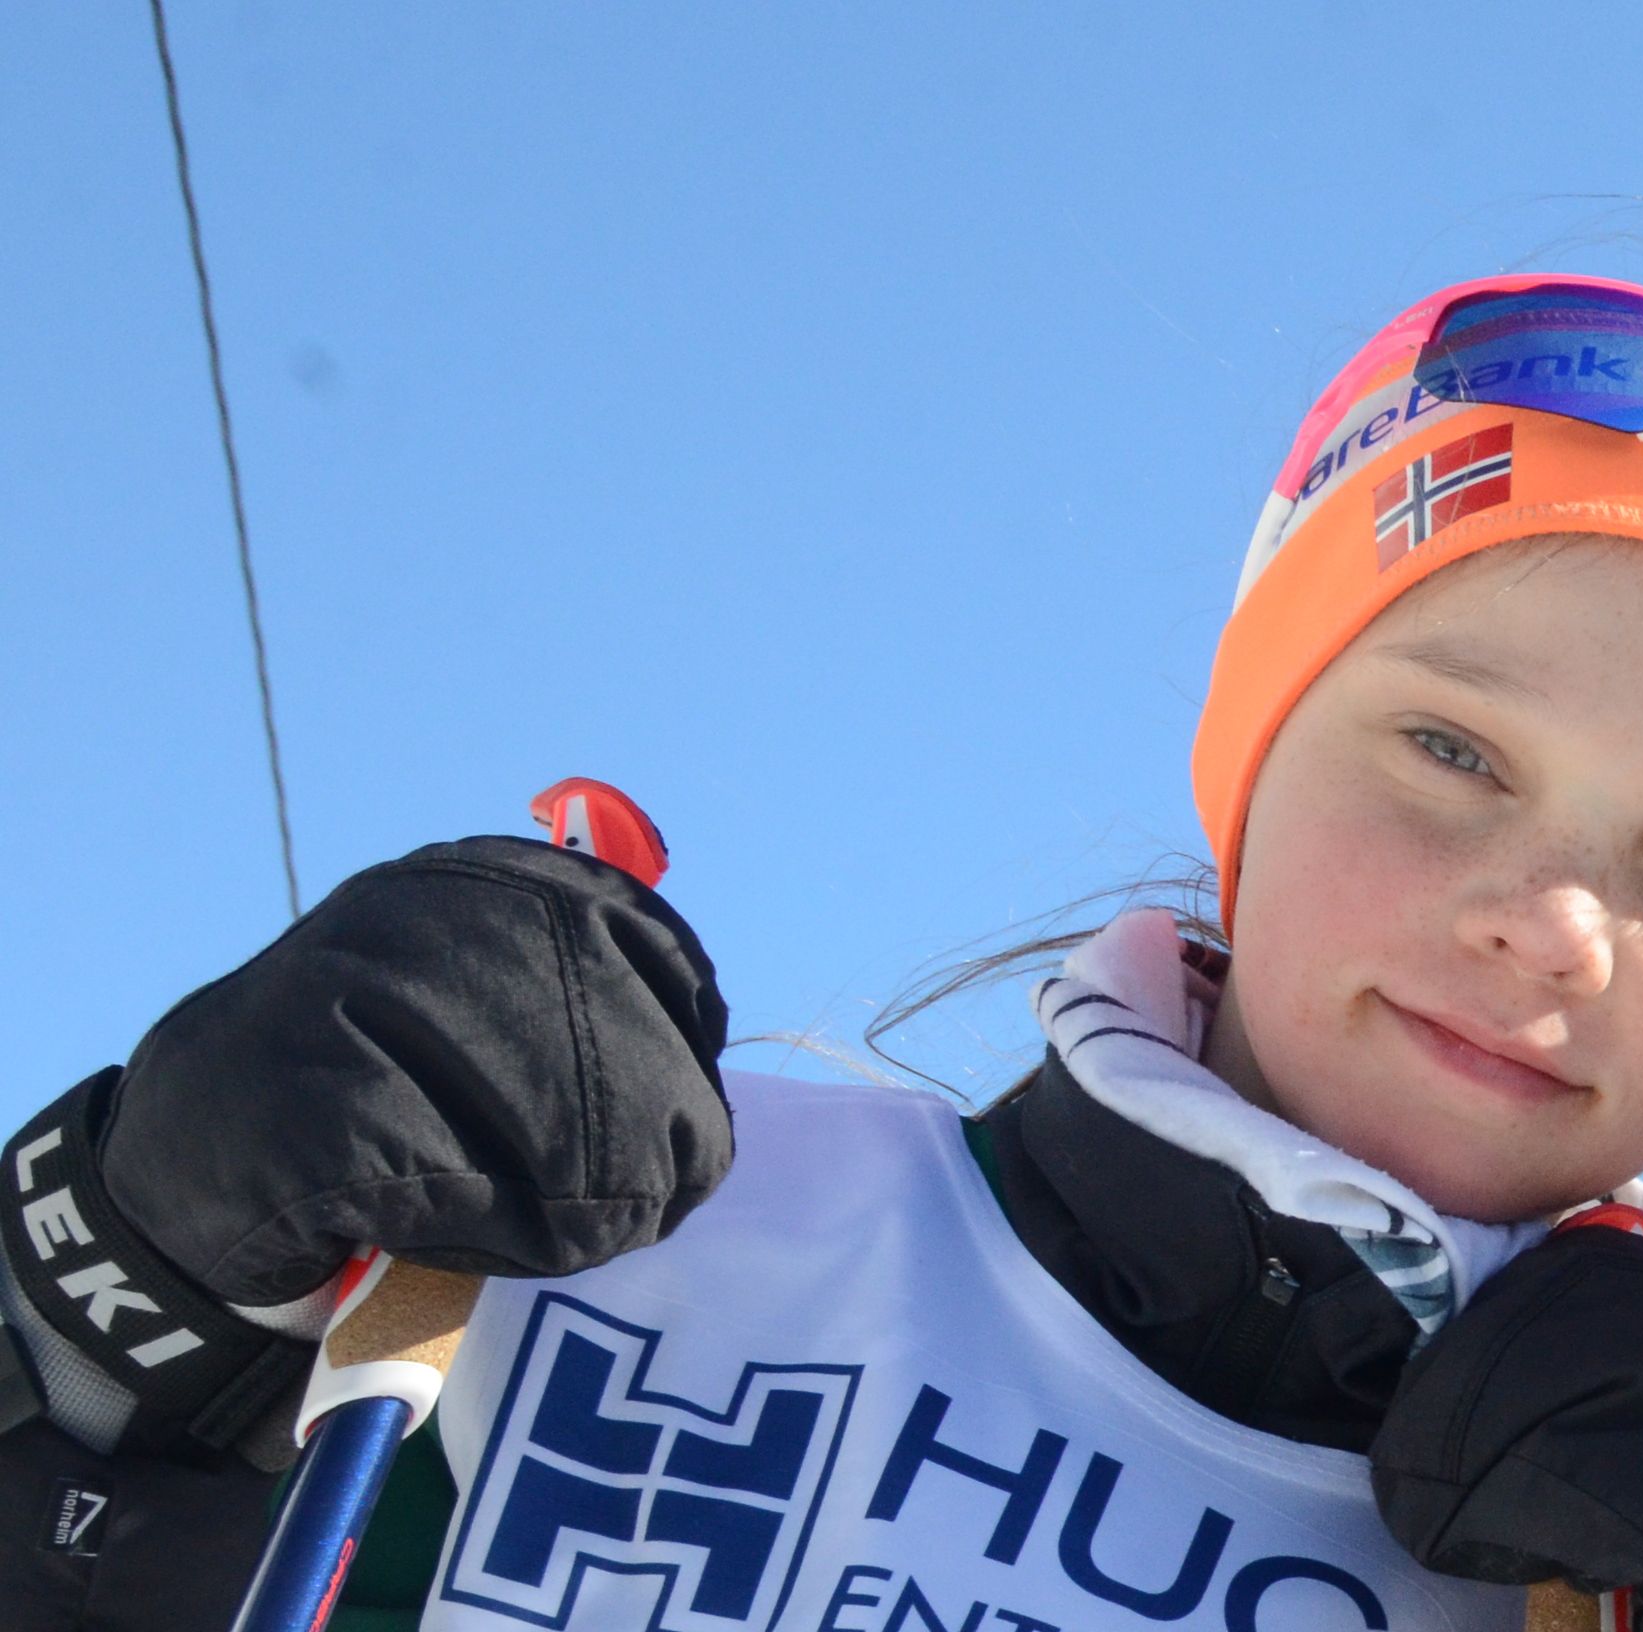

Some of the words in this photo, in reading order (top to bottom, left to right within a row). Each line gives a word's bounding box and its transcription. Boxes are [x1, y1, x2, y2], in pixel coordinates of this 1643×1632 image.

[1299, 346, 1630, 501] areBank
[15, 1126, 206, 1370] LEKI
[54, 1489, 79, 1544] norheim
